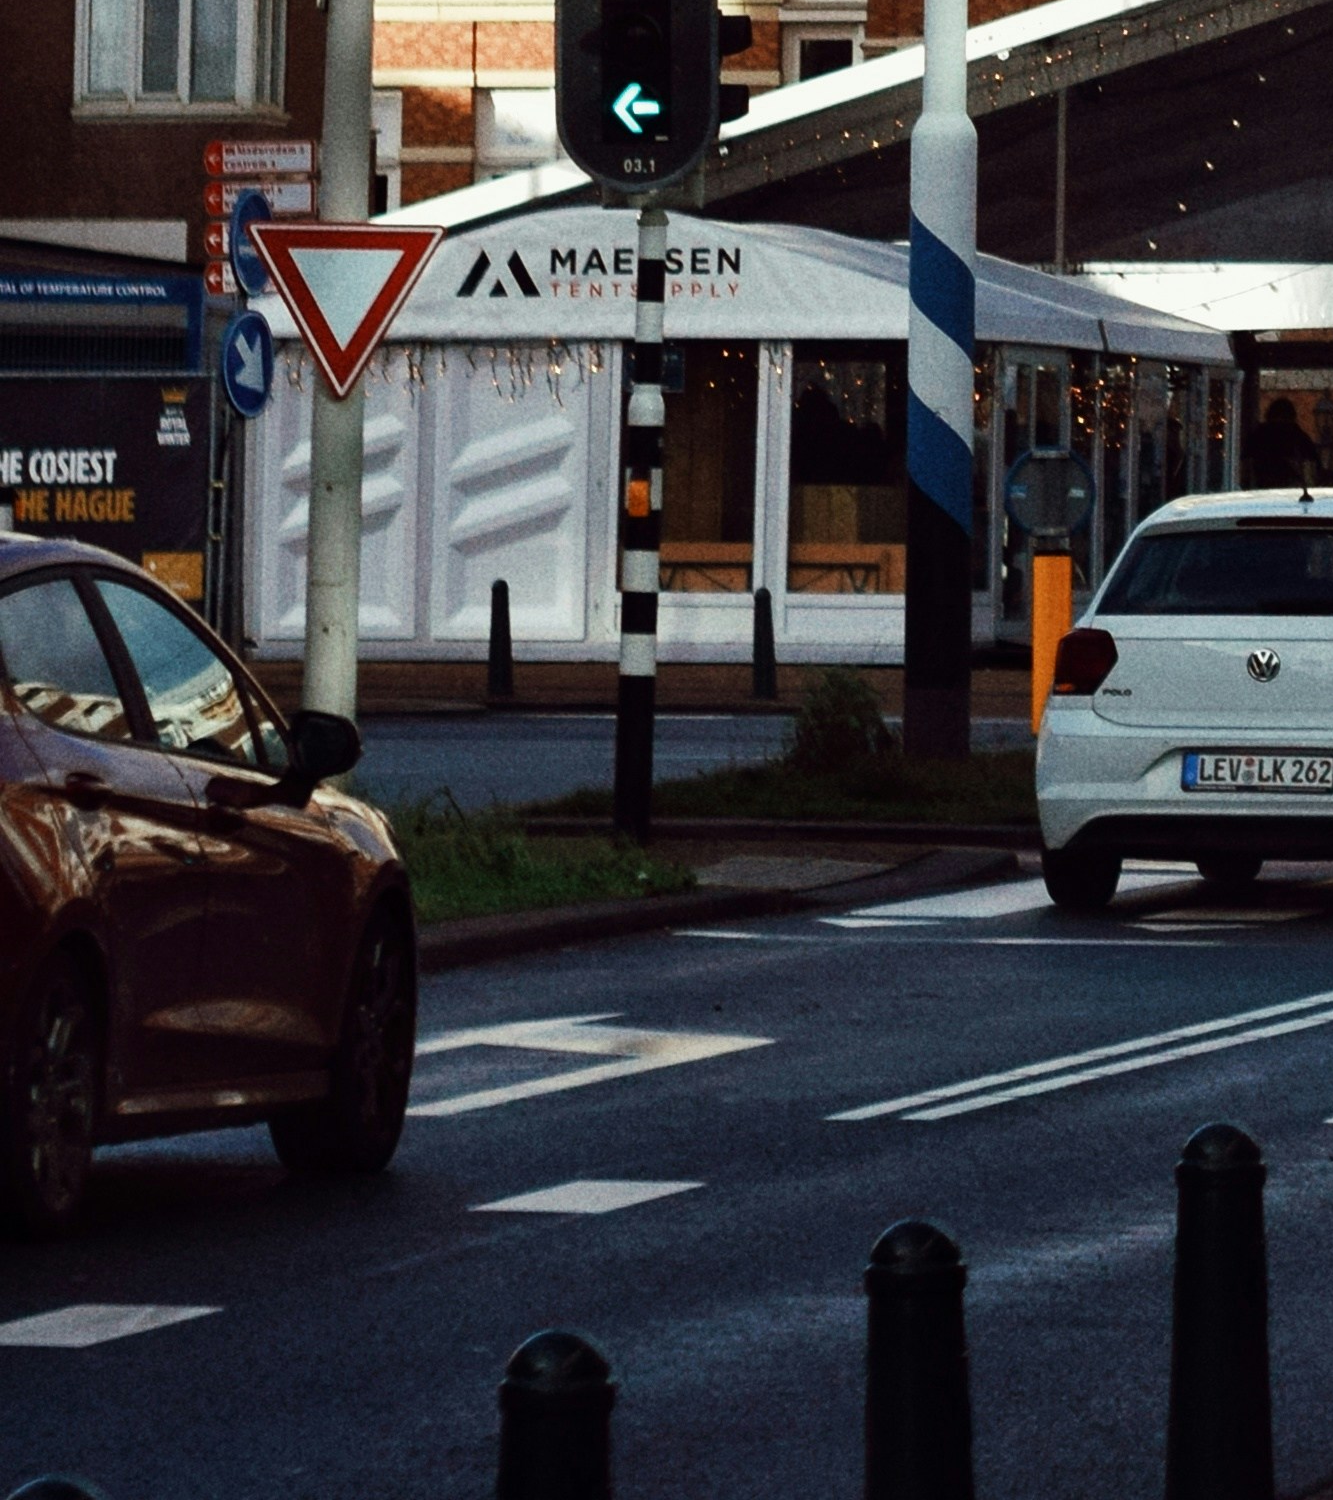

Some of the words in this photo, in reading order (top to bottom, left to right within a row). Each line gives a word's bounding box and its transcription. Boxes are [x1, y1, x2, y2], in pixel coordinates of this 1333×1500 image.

[624, 158, 656, 173] 03.1
[550, 247, 741, 275] MAESEN
[37, 283, 114, 297] TEMPERATURE
[115, 285, 168, 298] CONTROL
[29, 448, 117, 485] COSIEST
[55, 488, 135, 523] HAGUE
[1102, 688, 1132, 697] POLO
[1199, 757, 1242, 783] LEV
[1257, 758, 1287, 783] LK
[1291, 759, 1332, 785] 262
